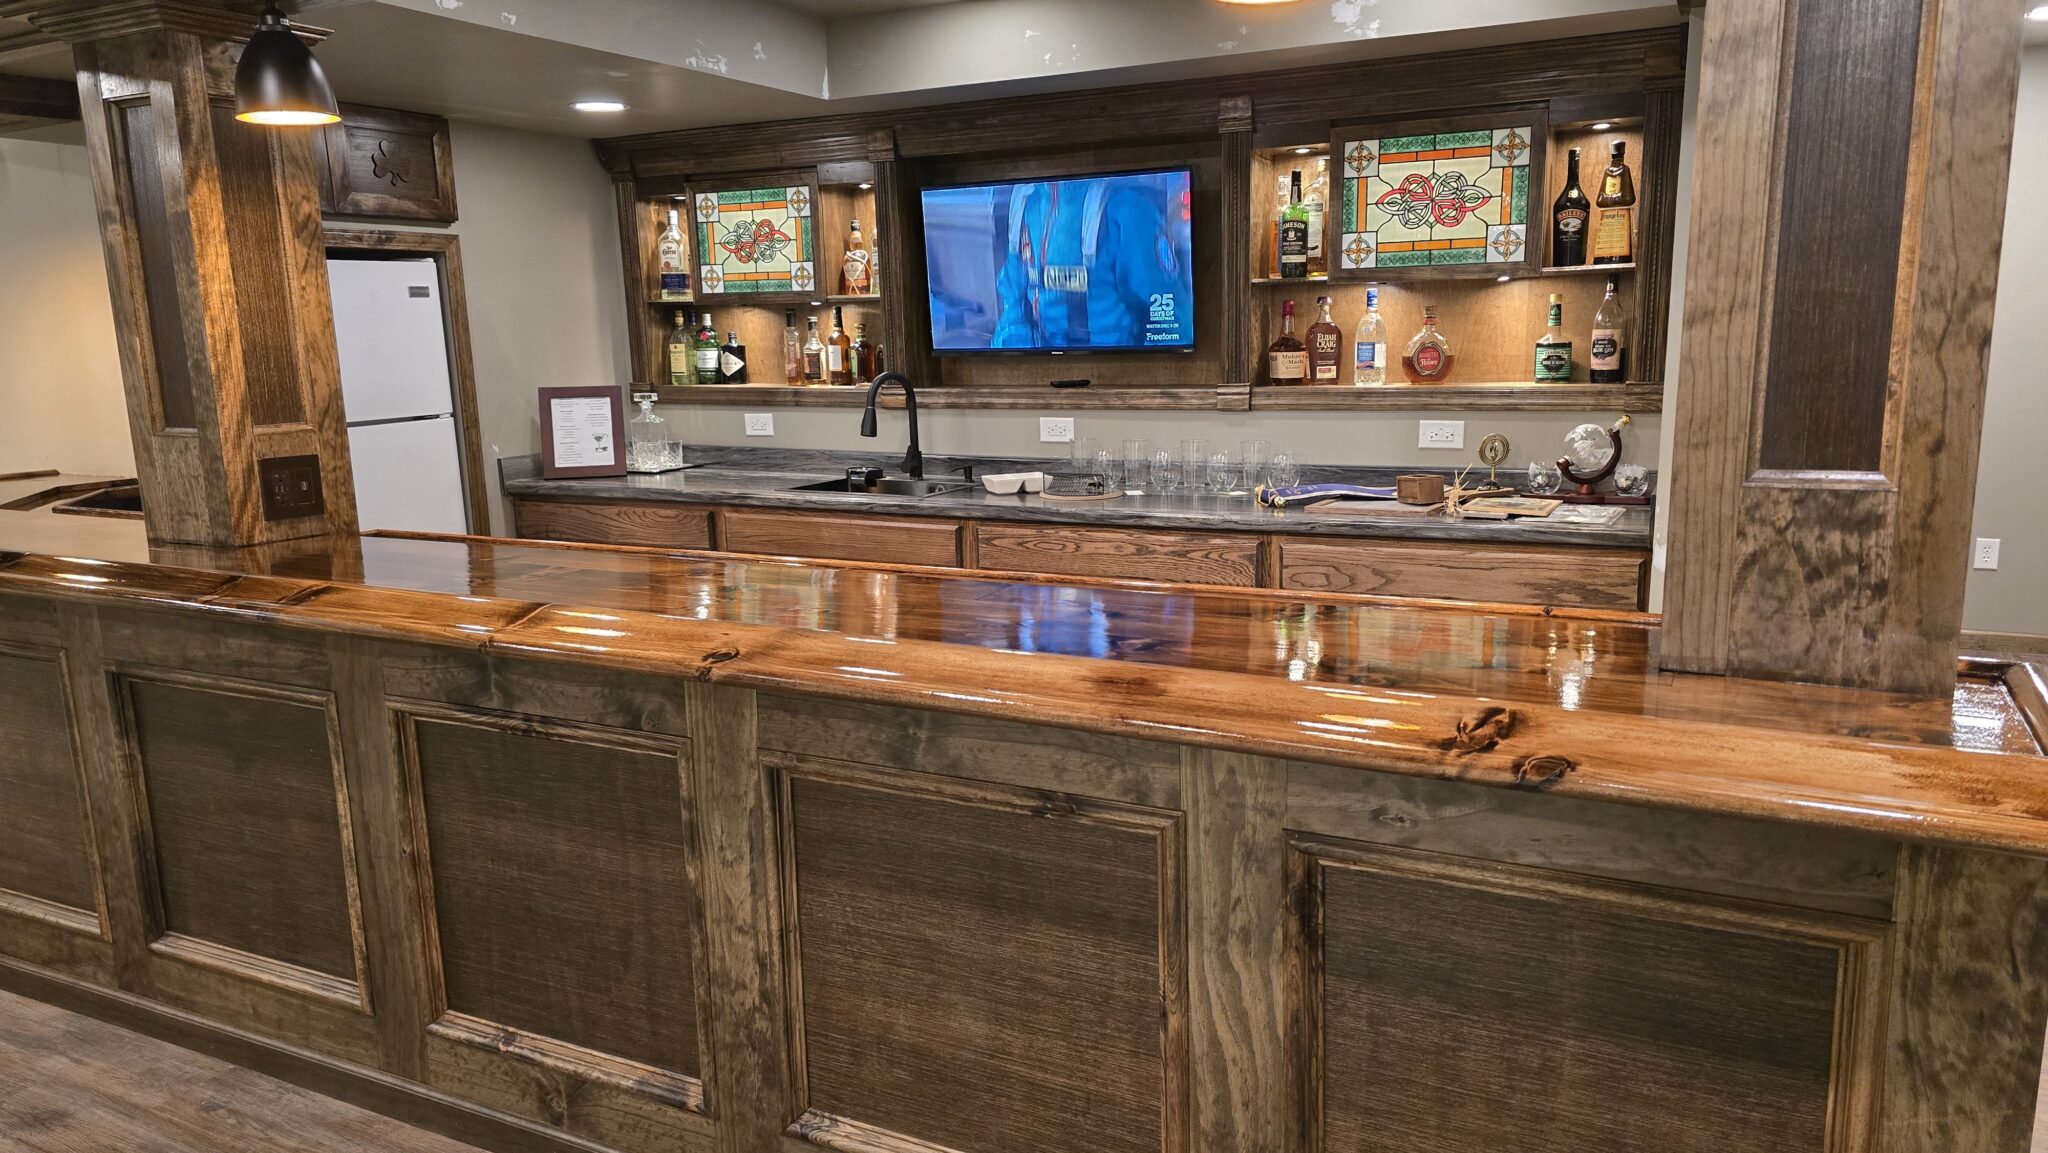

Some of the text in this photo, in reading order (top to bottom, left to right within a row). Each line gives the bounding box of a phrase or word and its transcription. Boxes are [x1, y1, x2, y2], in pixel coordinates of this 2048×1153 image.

[1557, 210, 1585, 220] BAILEYS
[1282, 221, 1306, 230] AMESON
[1150, 293, 1175, 310] 25
[1146, 332, 1180, 341] Freeform
[1317, 333, 1337, 341] ELIJAH
[1316, 340, 1336, 349] CRAIG
